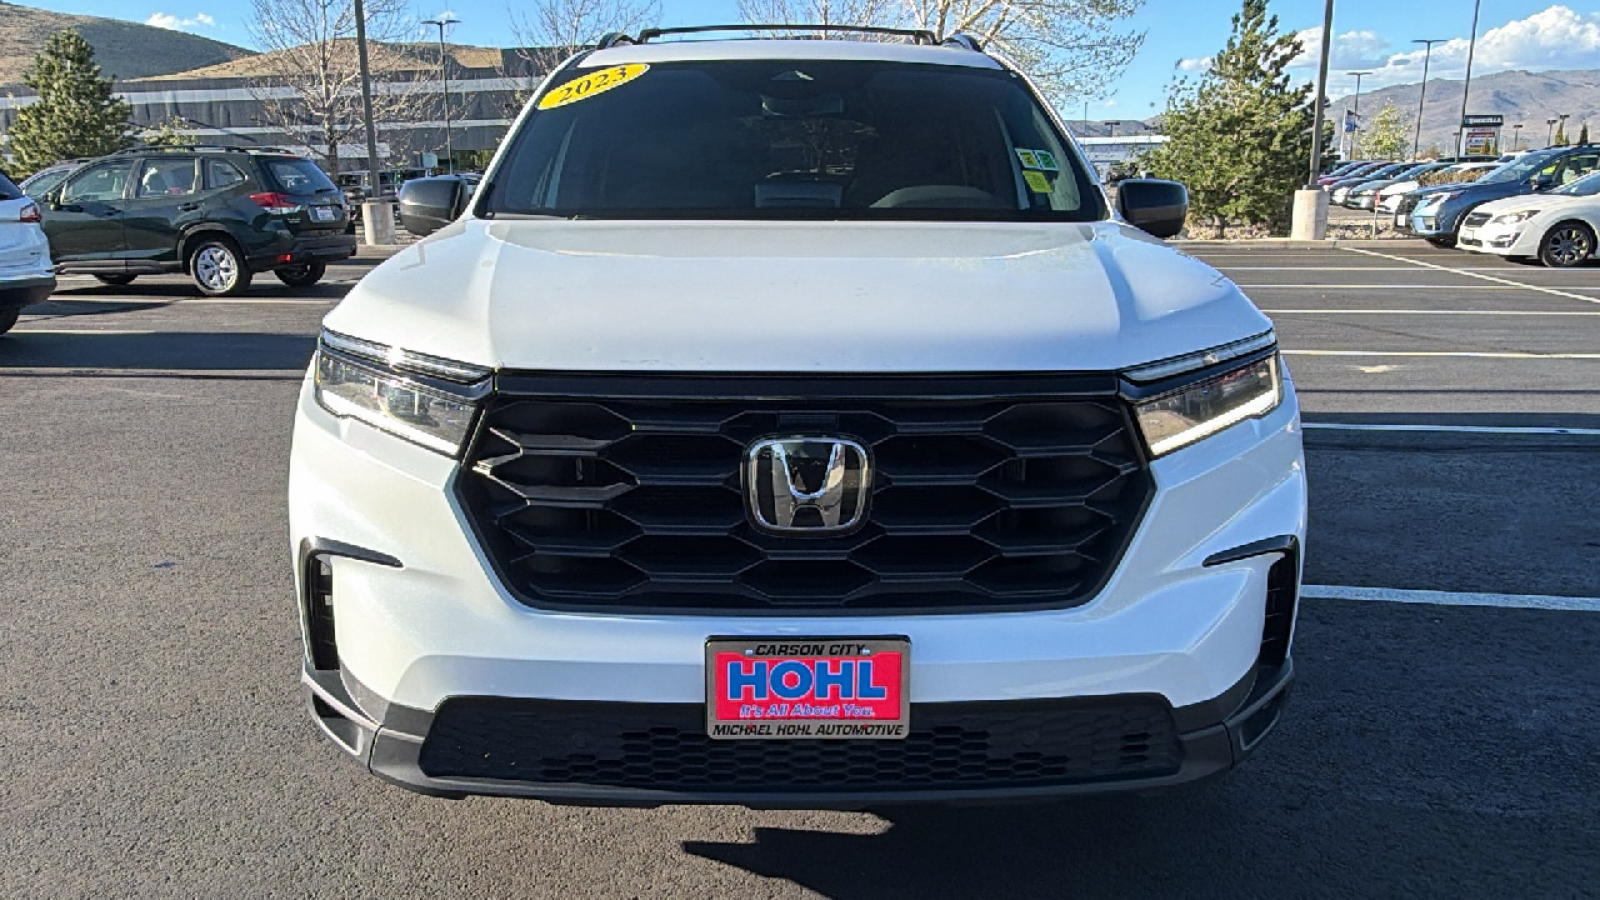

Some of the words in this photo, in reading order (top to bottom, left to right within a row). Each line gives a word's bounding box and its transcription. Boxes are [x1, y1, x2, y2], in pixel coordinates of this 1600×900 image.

[559, 67, 627, 102] 2023
[755, 644, 823, 656] CARSON
[829, 644, 866, 656] CITY
[727, 660, 888, 700] HOHL
[740, 704, 763, 718] It's
[766, 704, 789, 718] All
[791, 704, 840, 718] About
[843, 704, 876, 718] You.
[712, 724, 773, 736] MICHAEL
[776, 724, 812, 736] HOHL
[815, 724, 904, 736] AUTOMOTIVE
